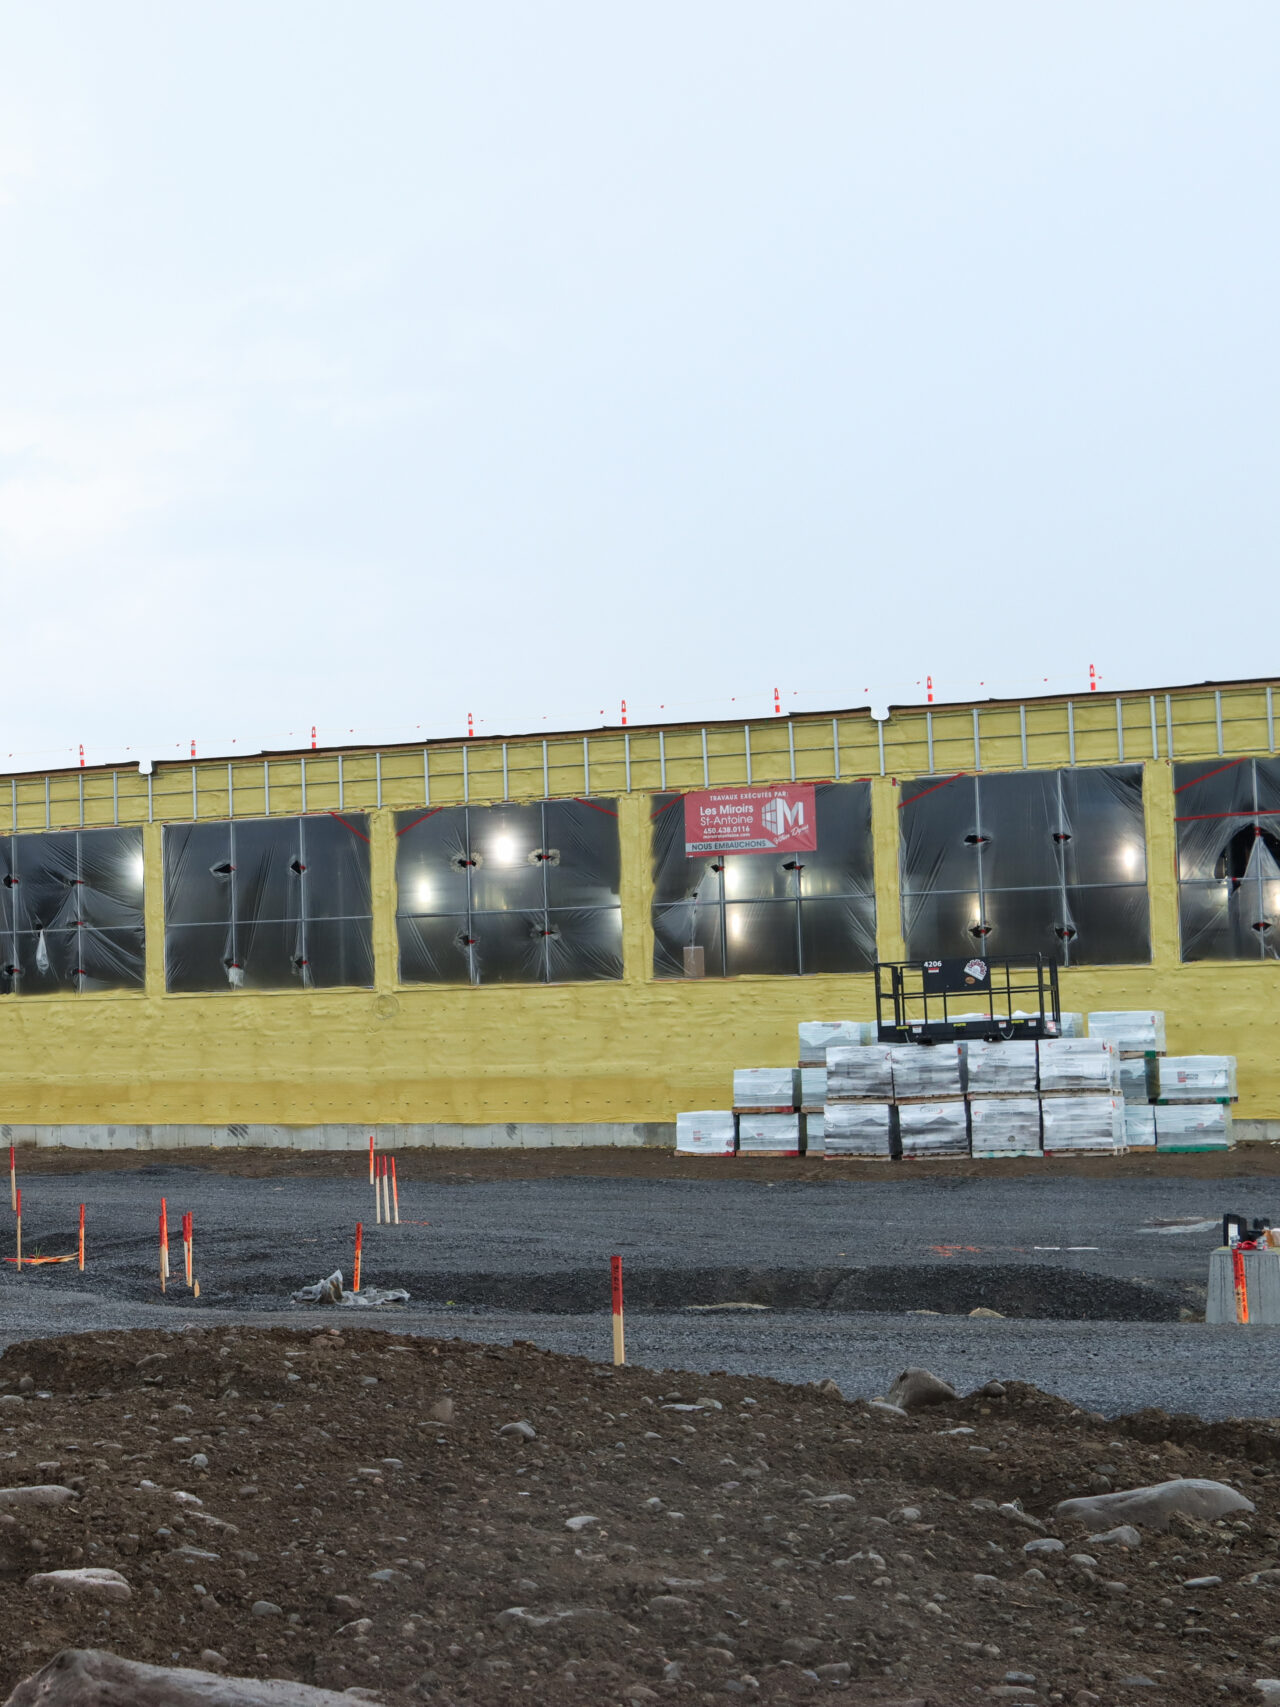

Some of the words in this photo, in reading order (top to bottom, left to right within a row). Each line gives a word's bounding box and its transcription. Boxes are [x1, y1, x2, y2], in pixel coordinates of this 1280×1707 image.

[700, 806, 717, 816] Les
[719, 803, 754, 815] Miroirs
[700, 815, 754, 826] St-Antoine
[691, 842, 713, 852] NOUS
[714, 839, 766, 850] EMBAUCHONS
[923, 960, 943, 968] 4206
